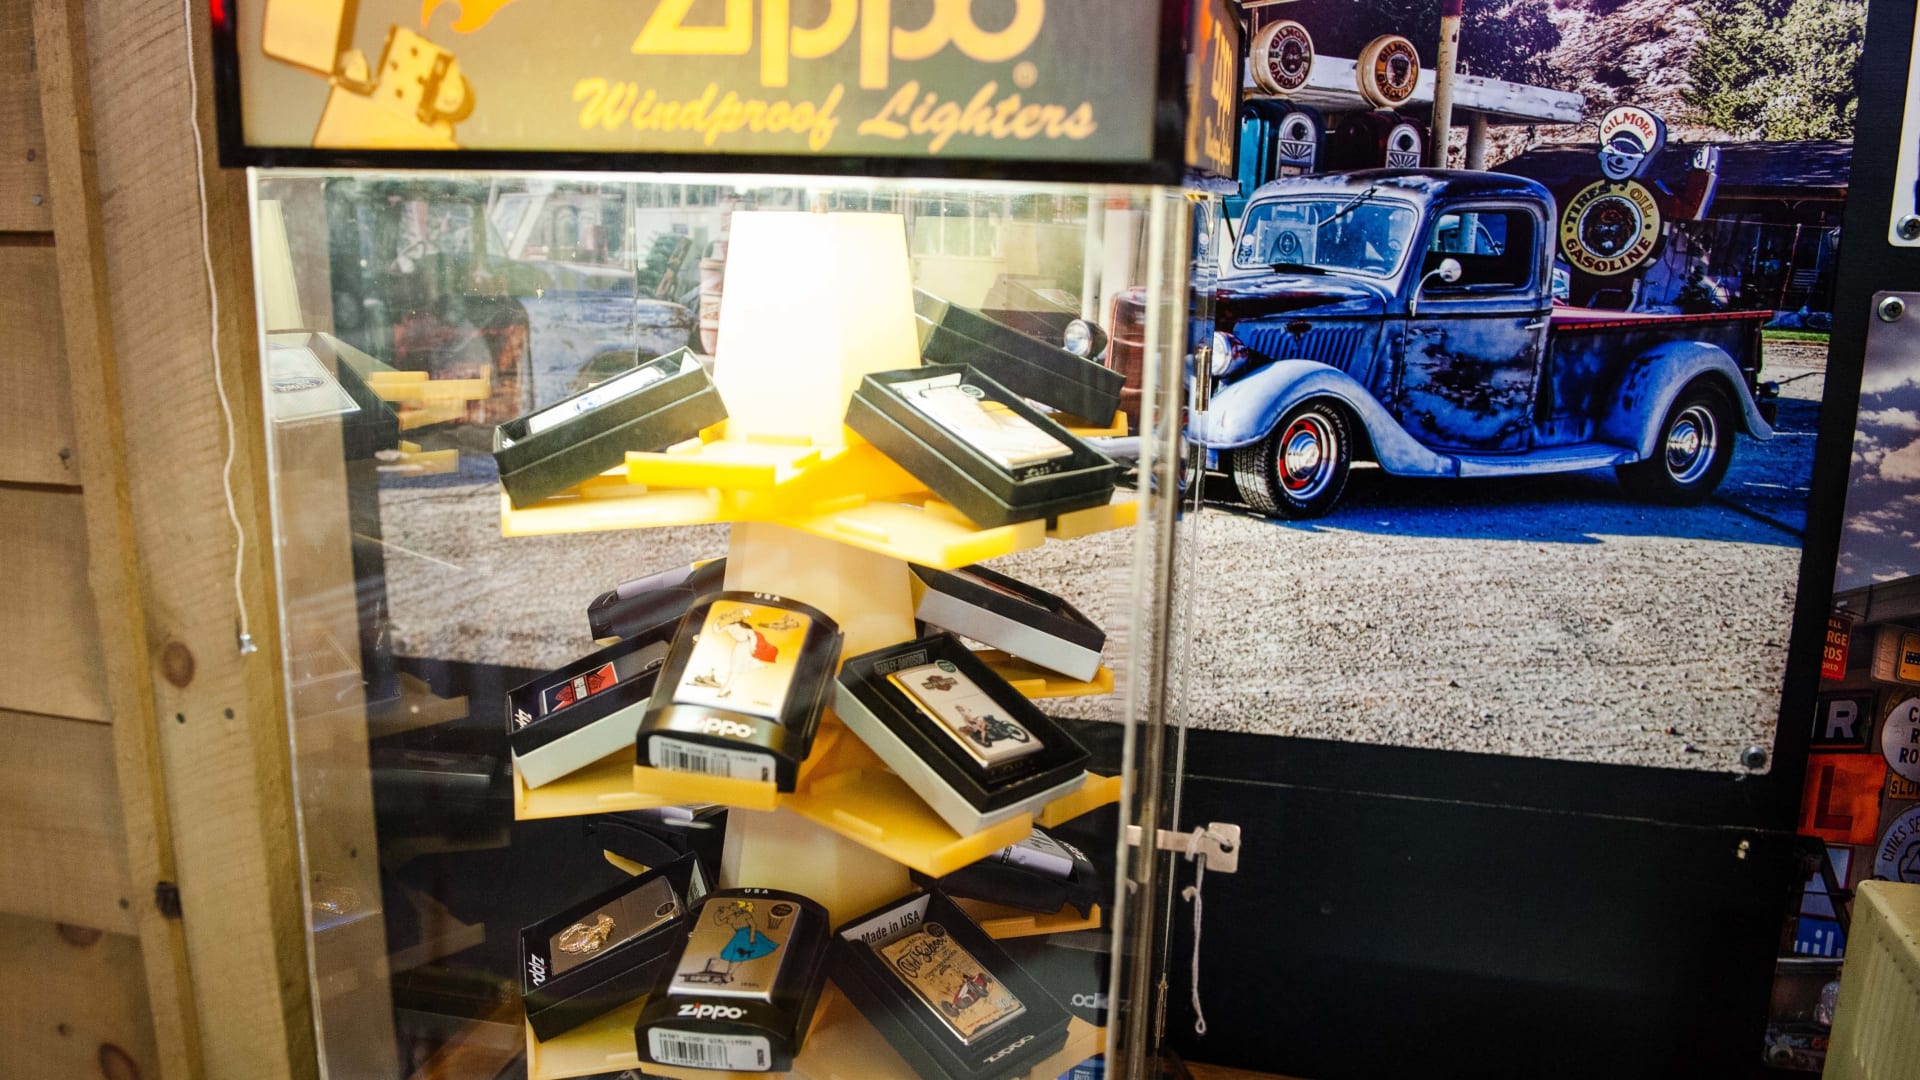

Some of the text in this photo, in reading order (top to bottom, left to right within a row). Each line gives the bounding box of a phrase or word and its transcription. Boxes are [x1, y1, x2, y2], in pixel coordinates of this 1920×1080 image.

[573, 80, 1098, 154] Windproof Lighters
[1603, 112, 1654, 139] GILMORE
[1629, 188, 1654, 218] OIL
[1565, 236, 1652, 272] GASOLINE
[753, 591, 781, 602] USA
[1825, 700, 1858, 738] R
[1813, 765, 1853, 830] L
[861, 926, 888, 945] Made
[888, 921, 899, 934] in
[900, 910, 921, 929] USA
